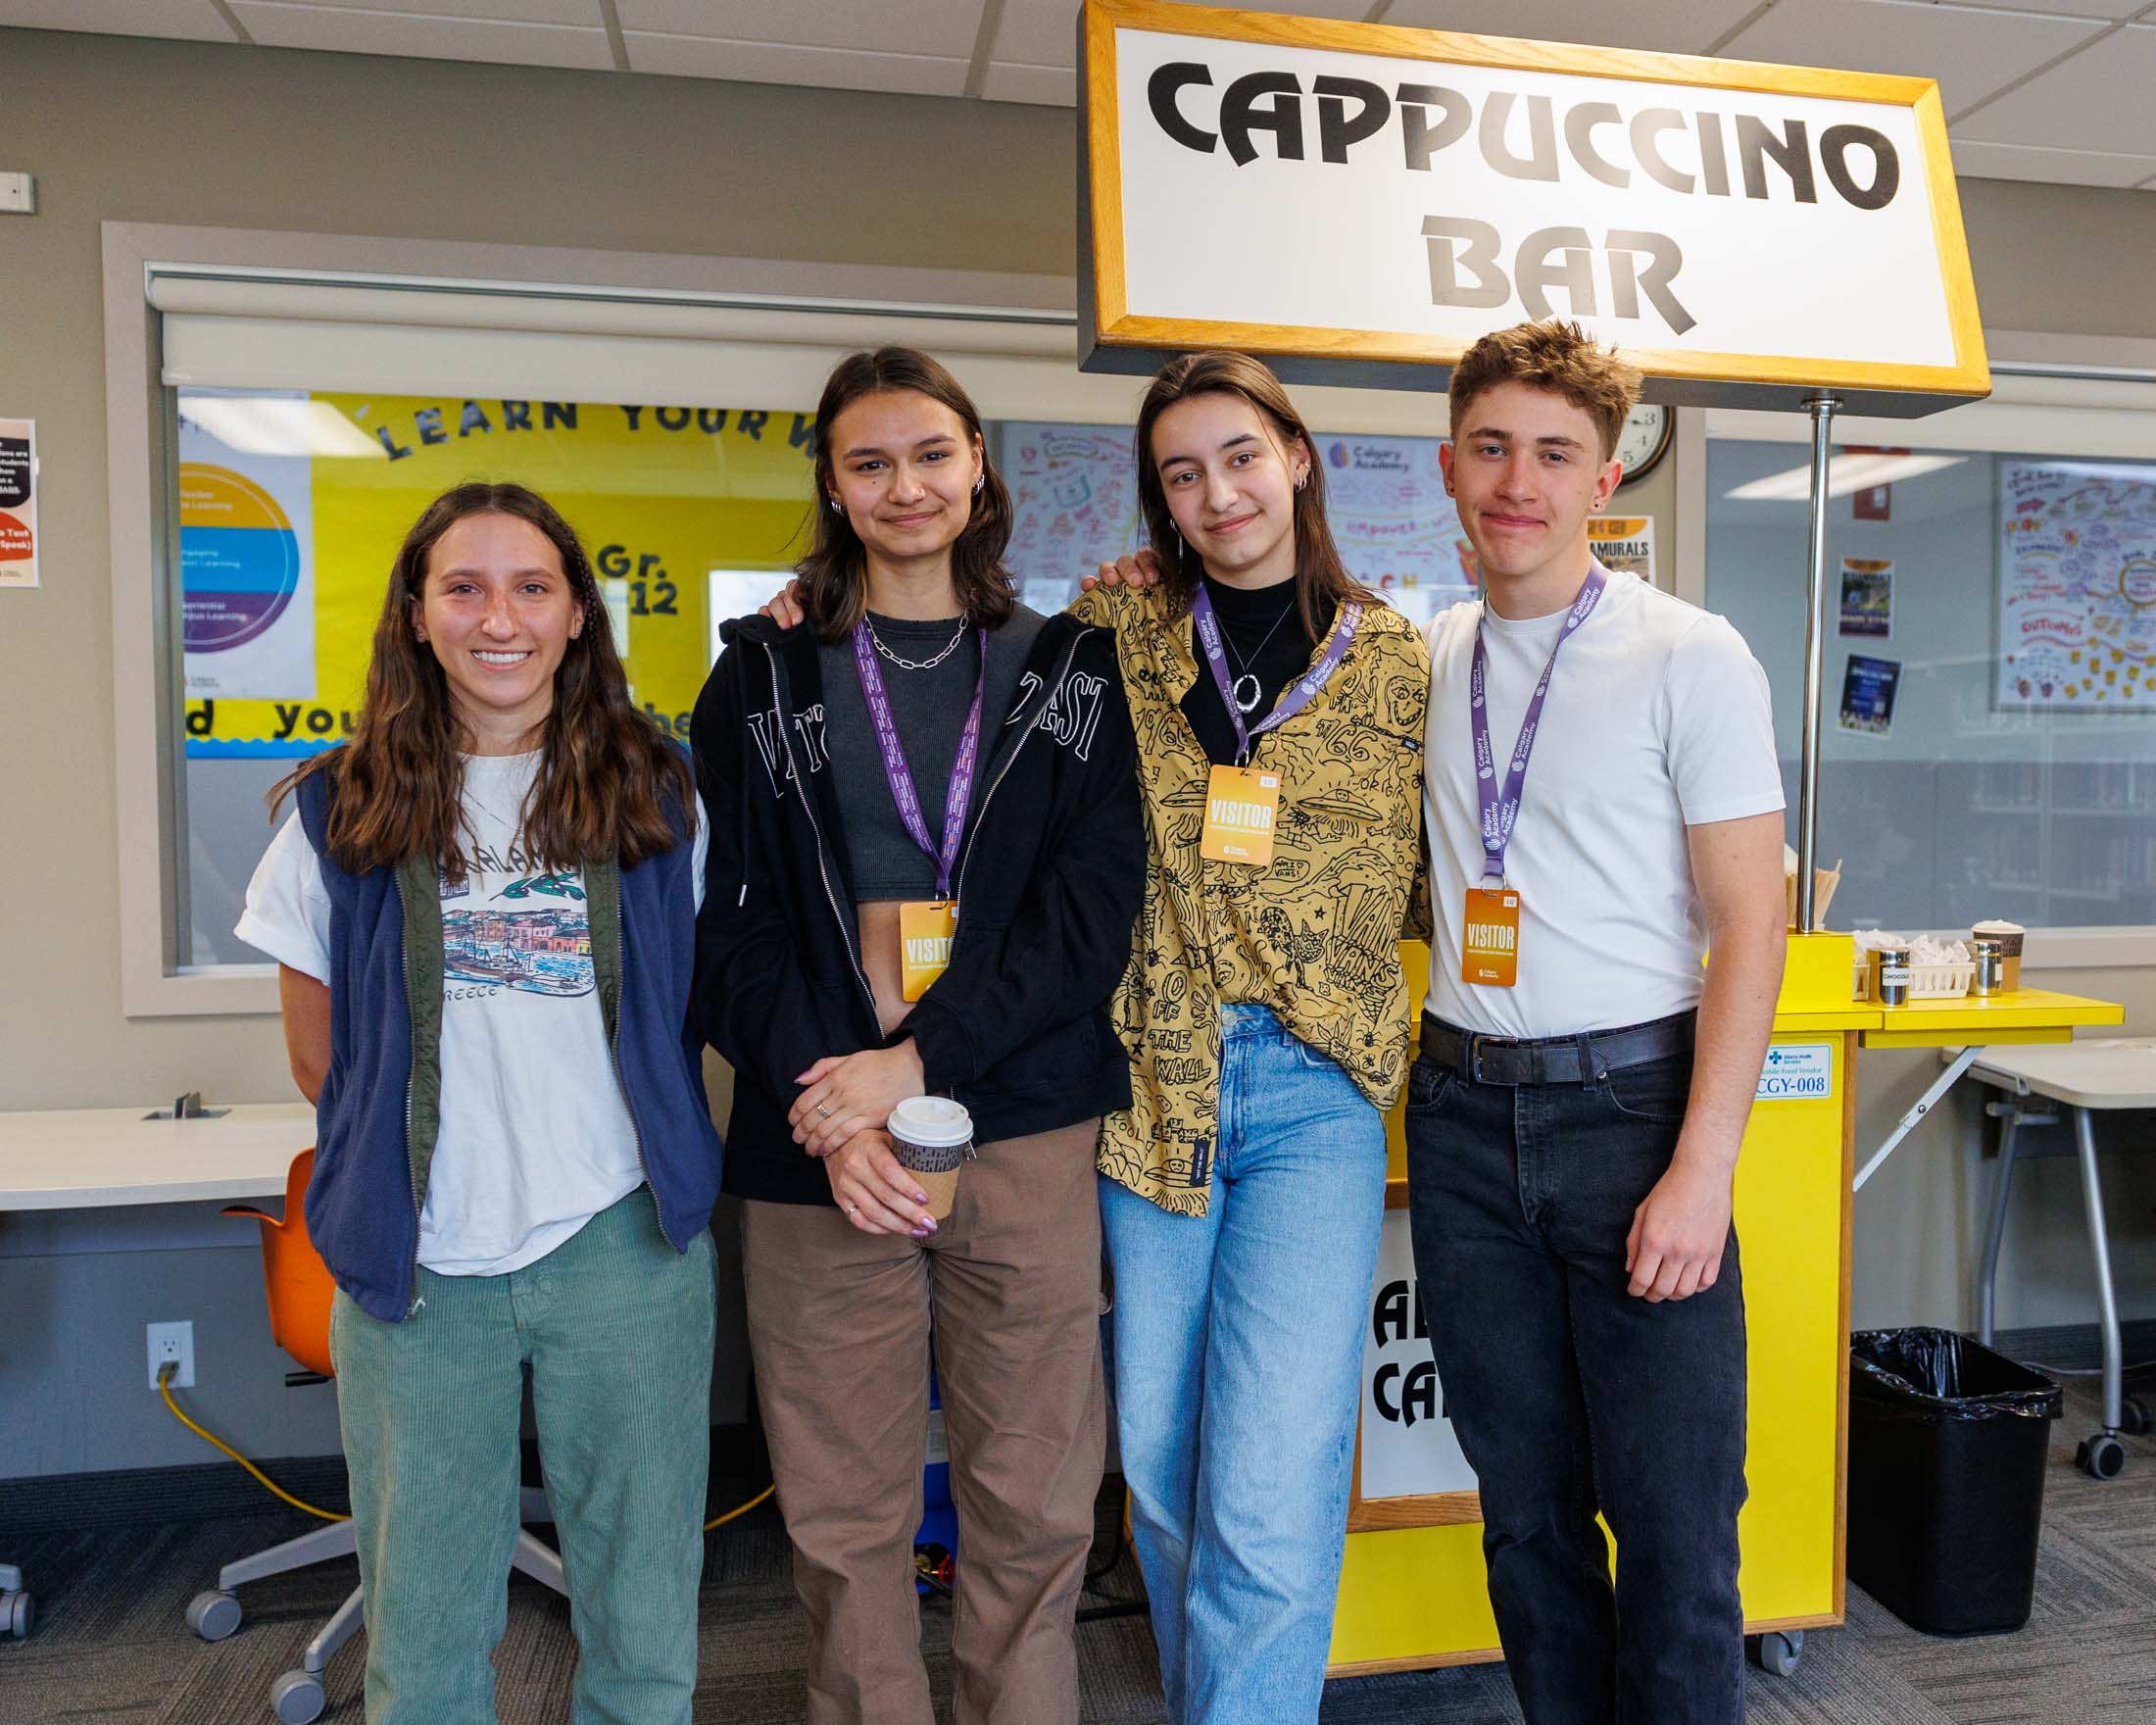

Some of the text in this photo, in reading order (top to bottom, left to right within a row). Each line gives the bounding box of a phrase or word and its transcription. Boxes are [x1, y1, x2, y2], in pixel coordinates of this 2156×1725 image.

[1147, 61, 1900, 211] CAPPUCCINO
[1420, 215, 1696, 336] BAR
[376, 400, 578, 462] LEARN
[619, 405, 768, 440] YOUR
[1645, 412, 1656, 425] 3
[1353, 446, 1402, 461] Calgary
[1638, 434, 1646, 446] 4
[1354, 460, 1410, 474] Academy
[1623, 449, 1634, 464] 5
[597, 545, 666, 578] Gr.
[1590, 542, 1648, 558] AMURALS
[630, 581, 678, 616] 12
[1574, 587, 1592, 616] Calgary
[1579, 587, 1600, 620] Academy
[1200, 619, 1213, 649] Calgary
[1205, 612, 1219, 645] Academy
[1309, 657, 1333, 682] Calgary
[1315, 658, 1341, 688] Academy
[1515, 726, 1530, 758] Calgary
[1521, 721, 1537, 759] Academy
[1211, 799, 1272, 829] VISITOR
[1490, 801, 1498, 837] Academy
[1467, 923, 1515, 950] VISITOR
[444, 984, 499, 1003] REECE
[1148, 1028, 1192, 1053] THE
[1153, 1056, 1211, 1085] WALL
[1756, 1076, 1825, 1094] CGY-008
[1373, 1279, 1431, 1350] A
[1373, 1360, 1450, 1429] CA
